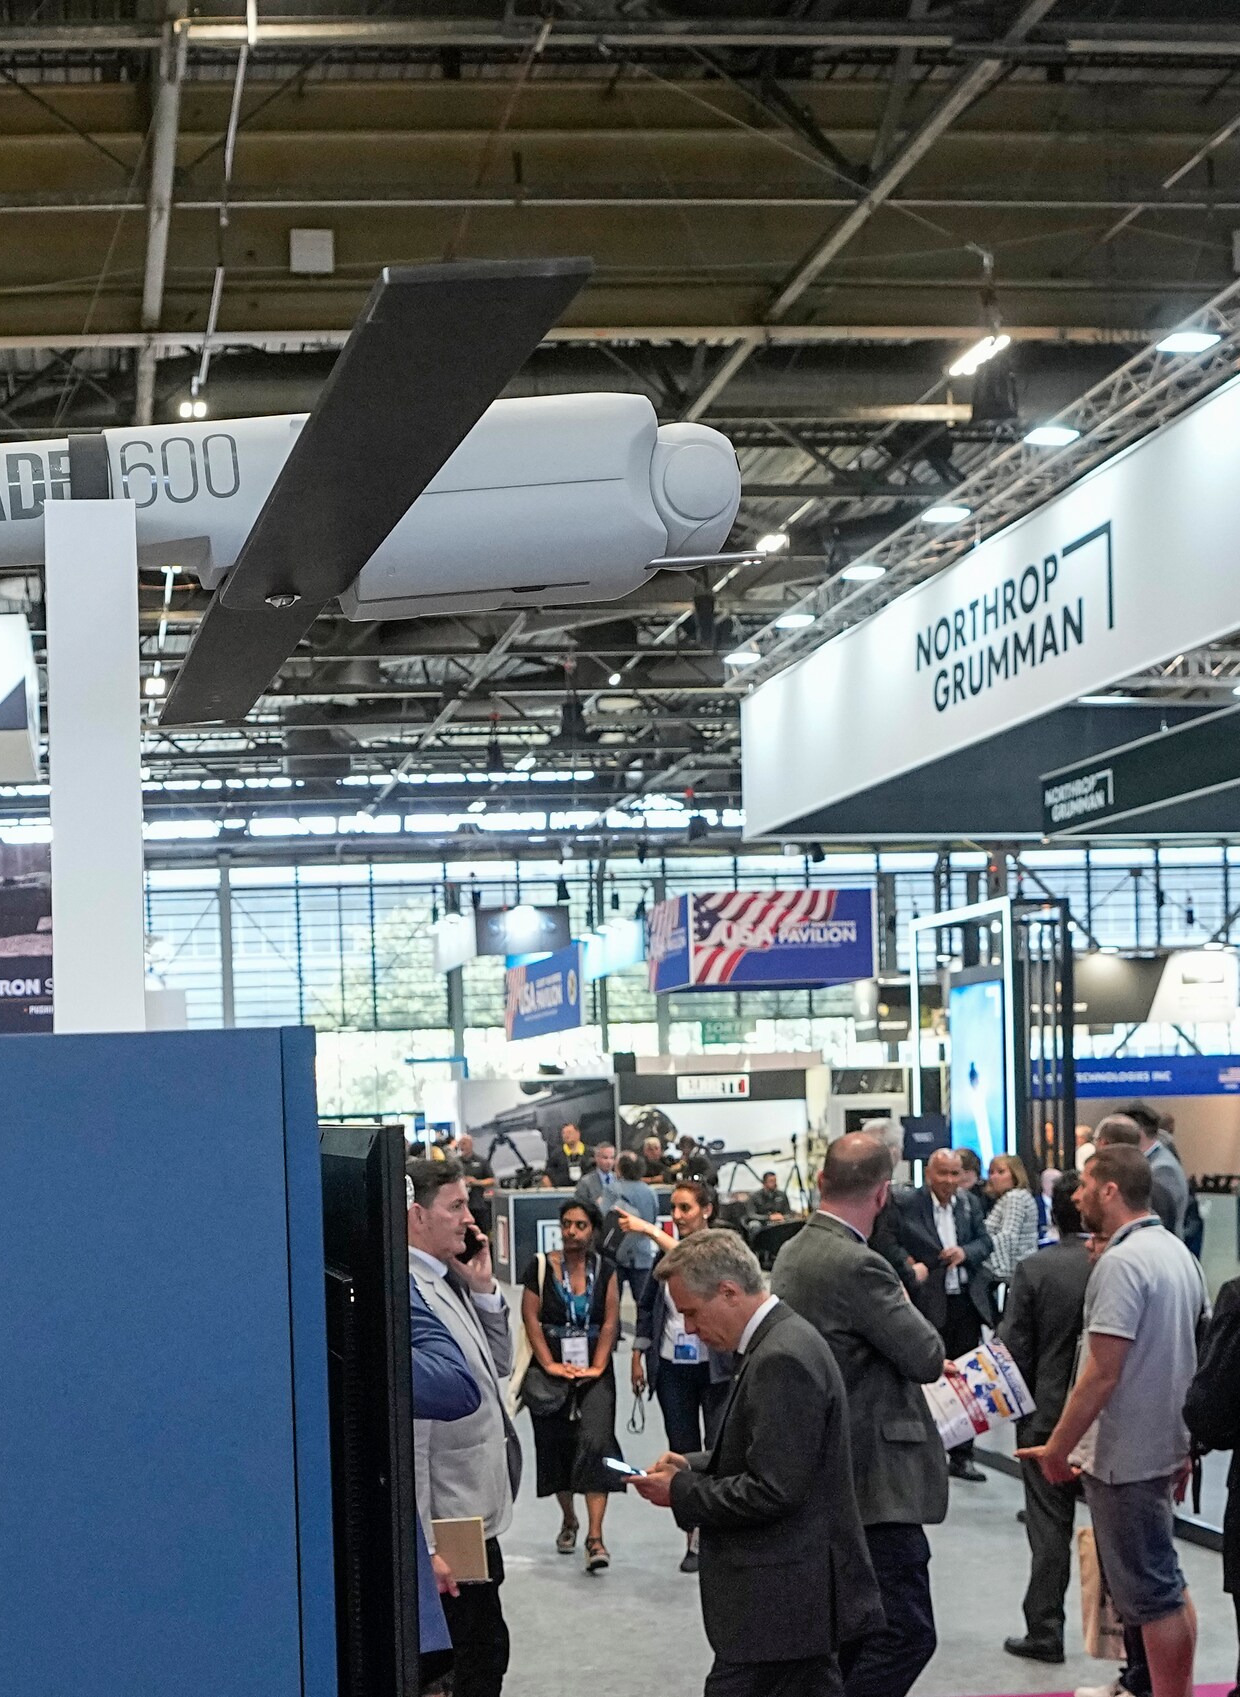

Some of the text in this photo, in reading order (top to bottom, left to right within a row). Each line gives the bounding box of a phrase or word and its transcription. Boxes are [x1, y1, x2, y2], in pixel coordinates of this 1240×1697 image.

[120, 433, 241, 509] 600
[916, 554, 1058, 672] NORTHROP
[934, 597, 1083, 712] GRUMMAN
[777, 925, 857, 944] PAVILION
[28, 1004, 53, 1015] PUSHI
